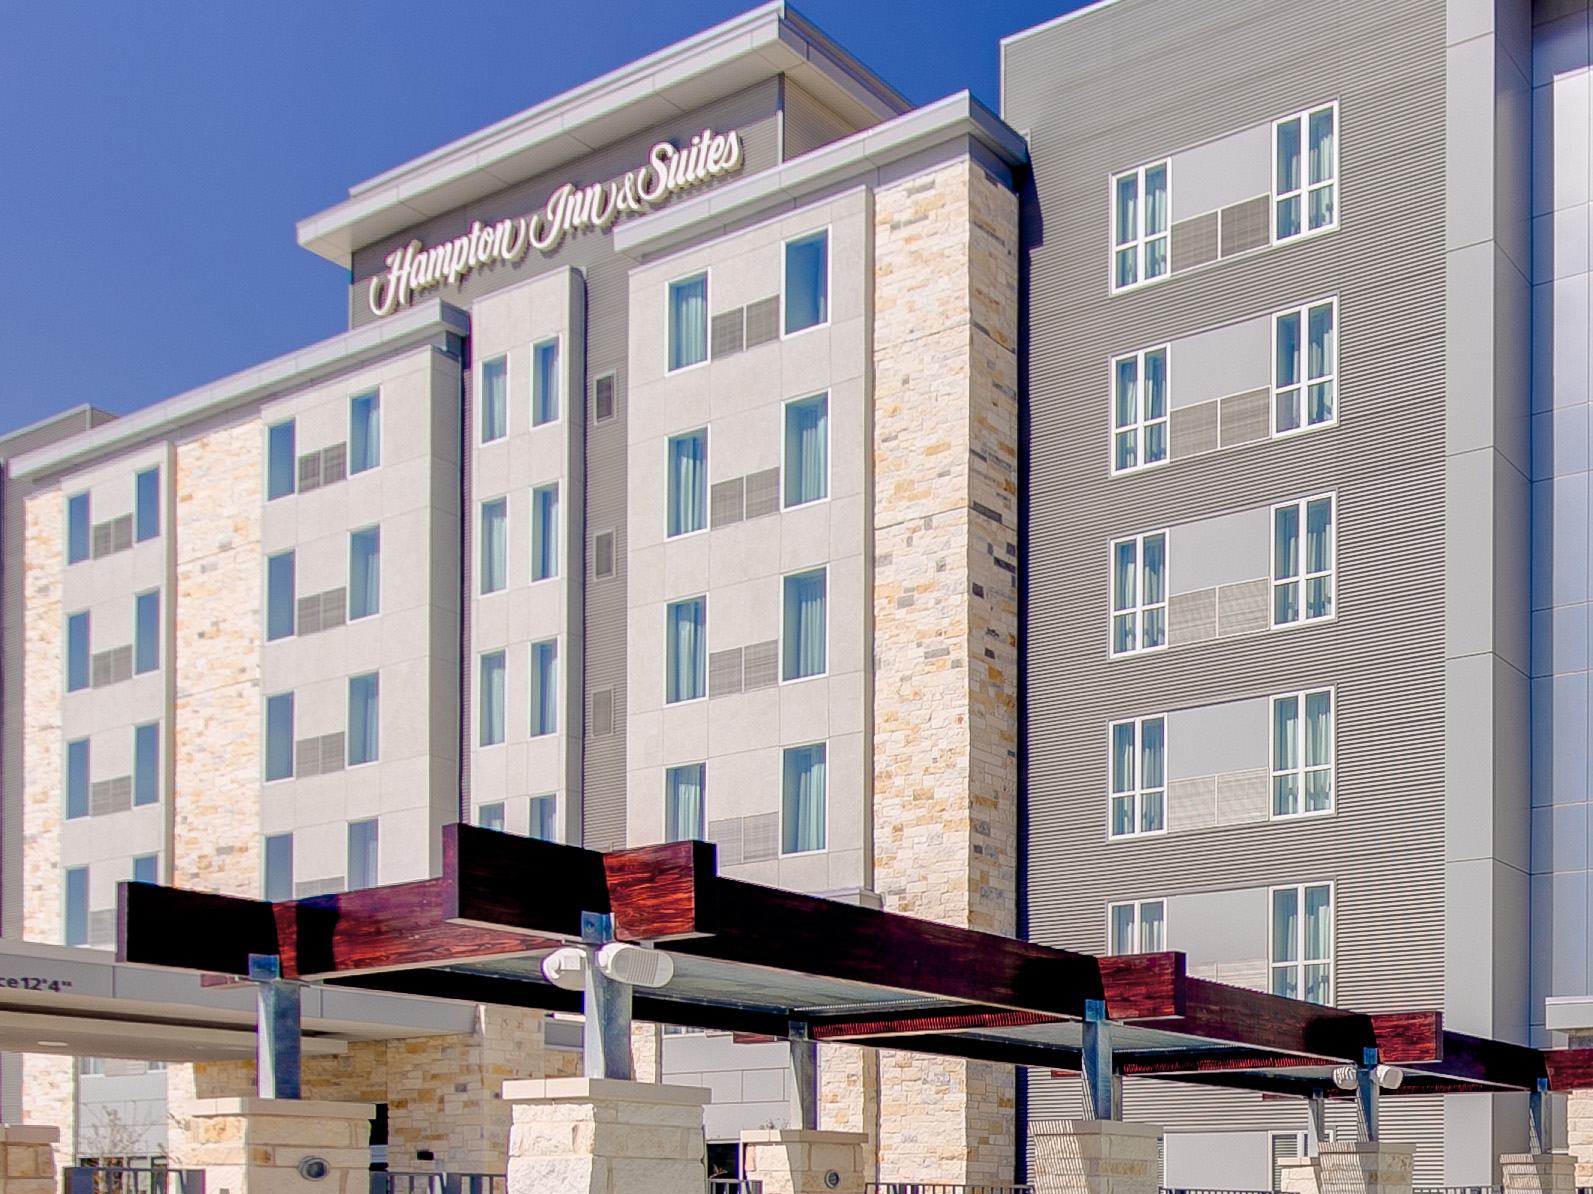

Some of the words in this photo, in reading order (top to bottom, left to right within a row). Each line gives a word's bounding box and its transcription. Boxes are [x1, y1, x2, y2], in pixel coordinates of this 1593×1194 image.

[368, 219, 528, 316] Hampton
[529, 183, 619, 250] Inn
[616, 171, 643, 210] &
[637, 128, 743, 203] Suites
